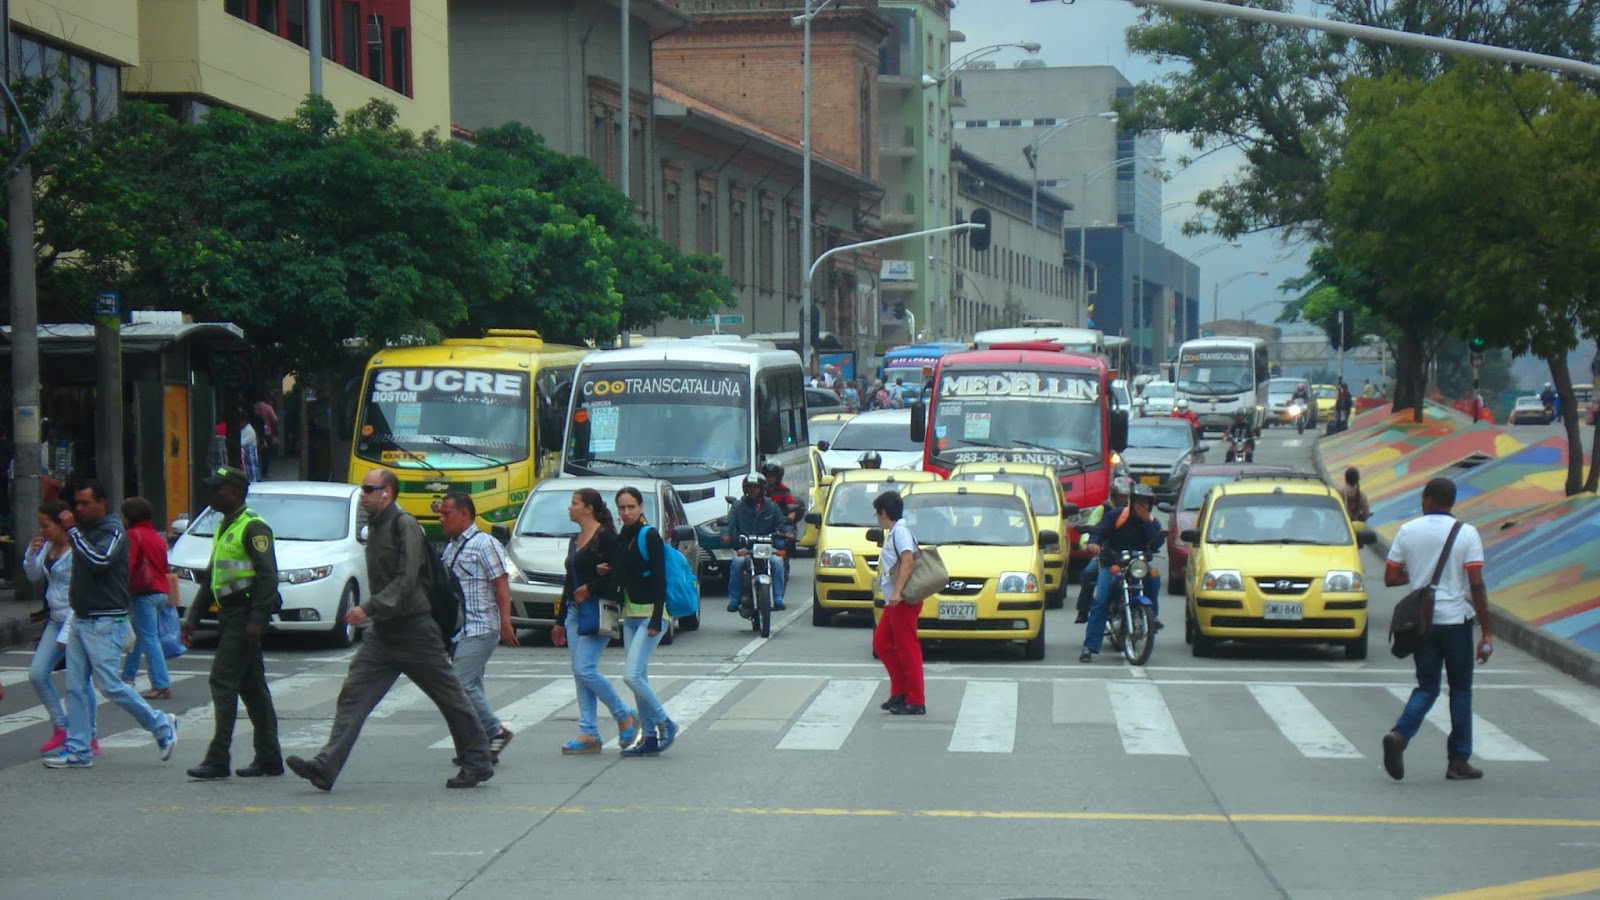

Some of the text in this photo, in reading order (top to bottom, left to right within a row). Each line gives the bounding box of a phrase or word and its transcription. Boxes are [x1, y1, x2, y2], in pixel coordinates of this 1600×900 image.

[372, 391, 418, 402] BOSTON
[374, 370, 522, 397] SUCRE
[941, 374, 1099, 400] MEDELLIN
